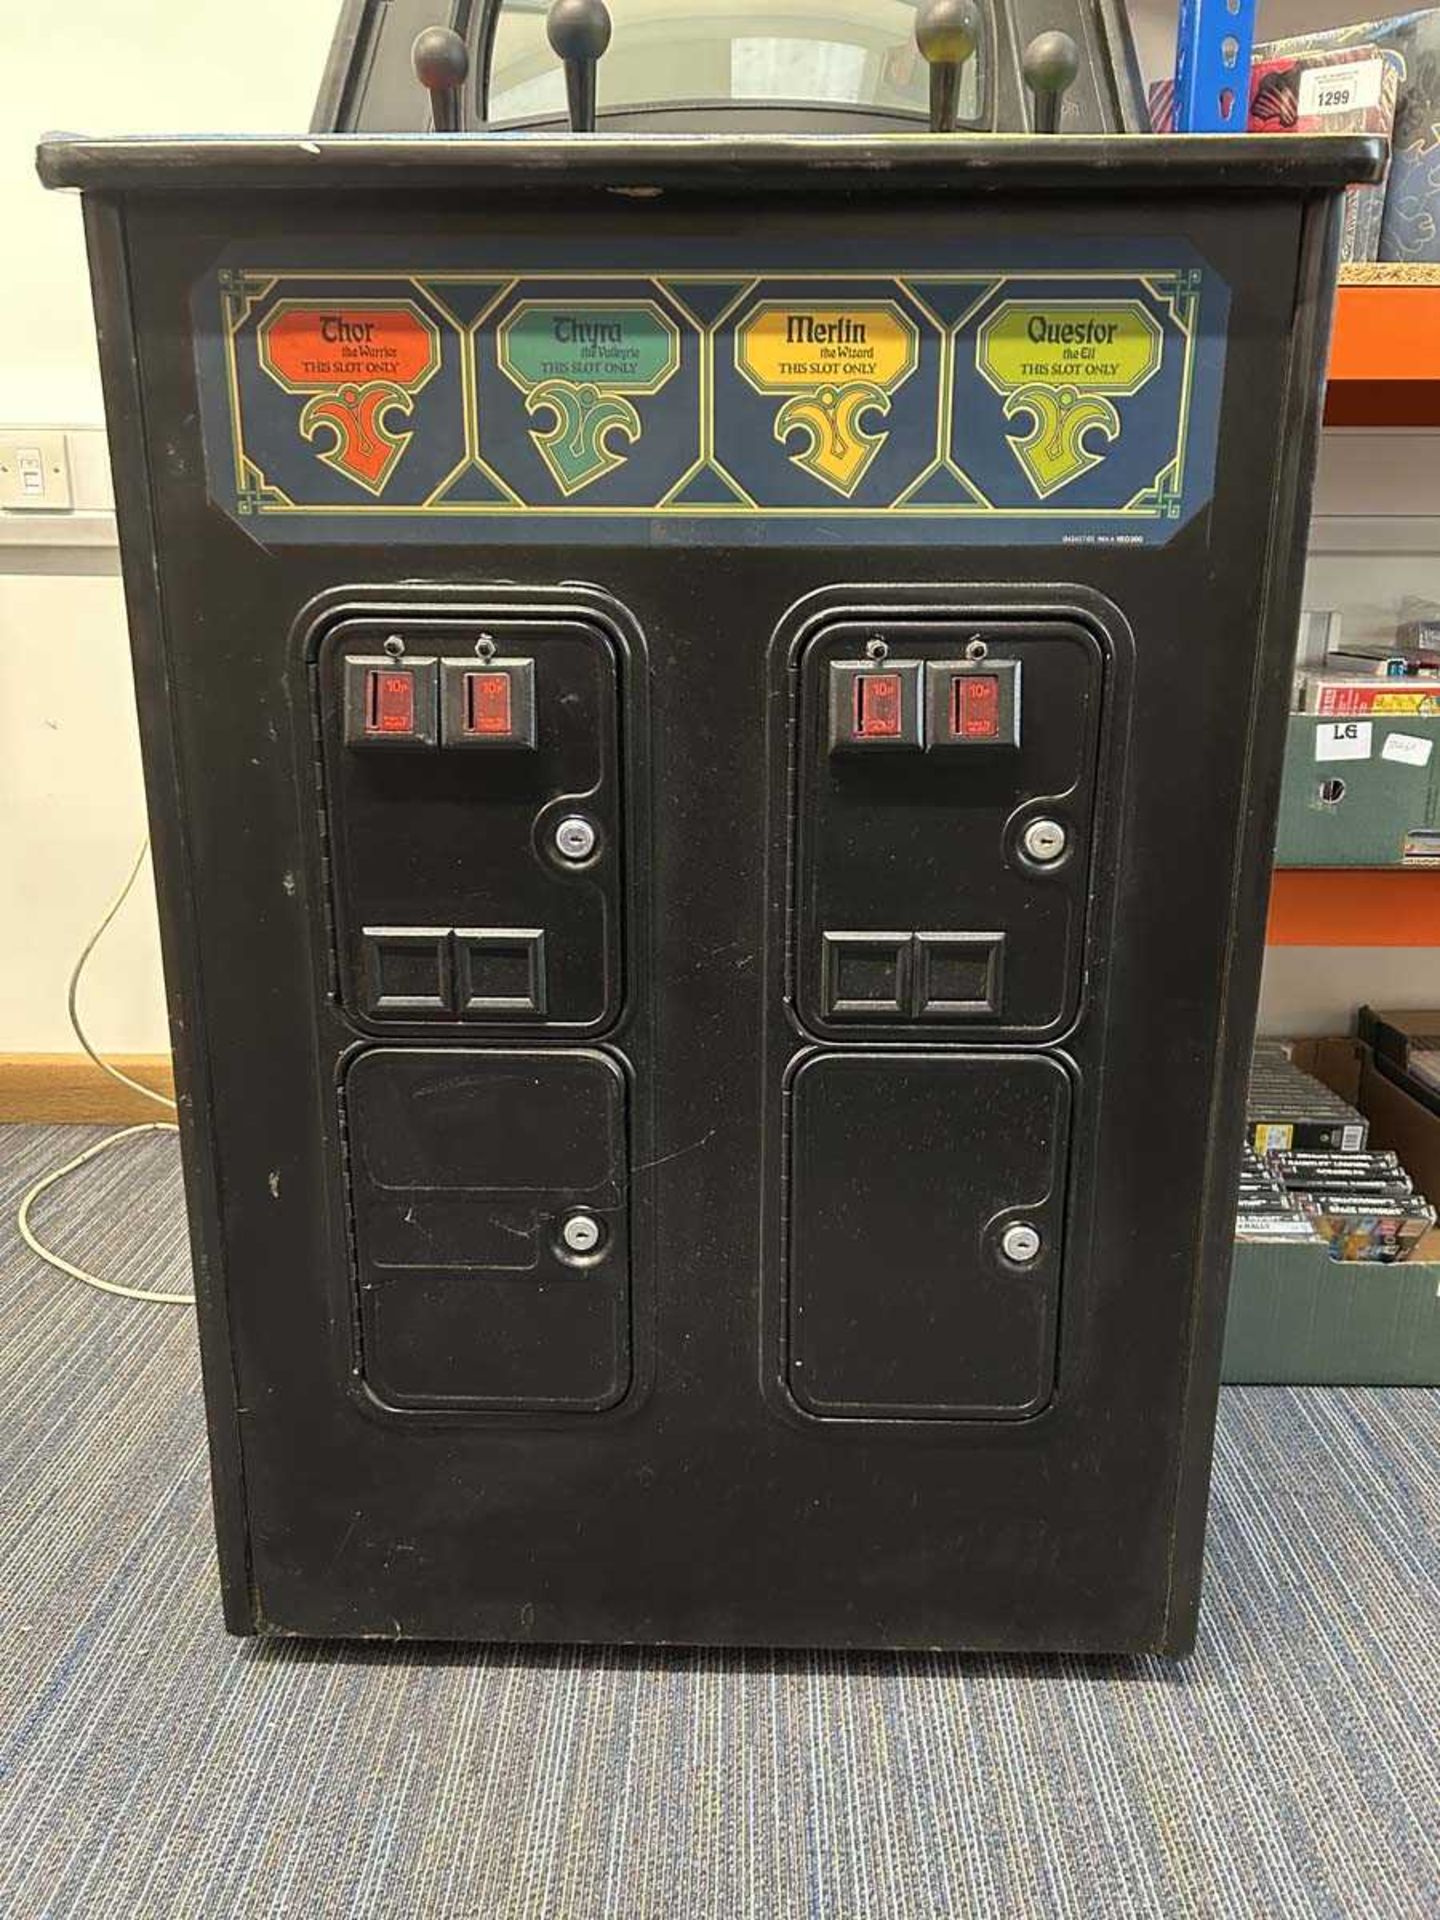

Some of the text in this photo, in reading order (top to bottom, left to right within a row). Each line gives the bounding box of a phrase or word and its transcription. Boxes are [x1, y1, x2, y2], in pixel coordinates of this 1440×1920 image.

[1318, 89, 1350, 106] 1299
[319, 316, 375, 343] Thor
[552, 316, 623, 347] Thyra
[786, 315, 866, 343] Merlin
[1027, 315, 1118, 344] Questor
[342, 346, 358, 357] the
[820, 346, 874, 359] the Wizard
[1063, 347, 1079, 360] the
[302, 362, 399, 373] THIS SLOT ONLY
[541, 362, 638, 374] THIS SLOT ONLY
[779, 362, 877, 374] THIS SLOT ONLY
[1021, 364, 1119, 375] THIS SLOT ONLY
[1333, 724, 1358, 740] LG
